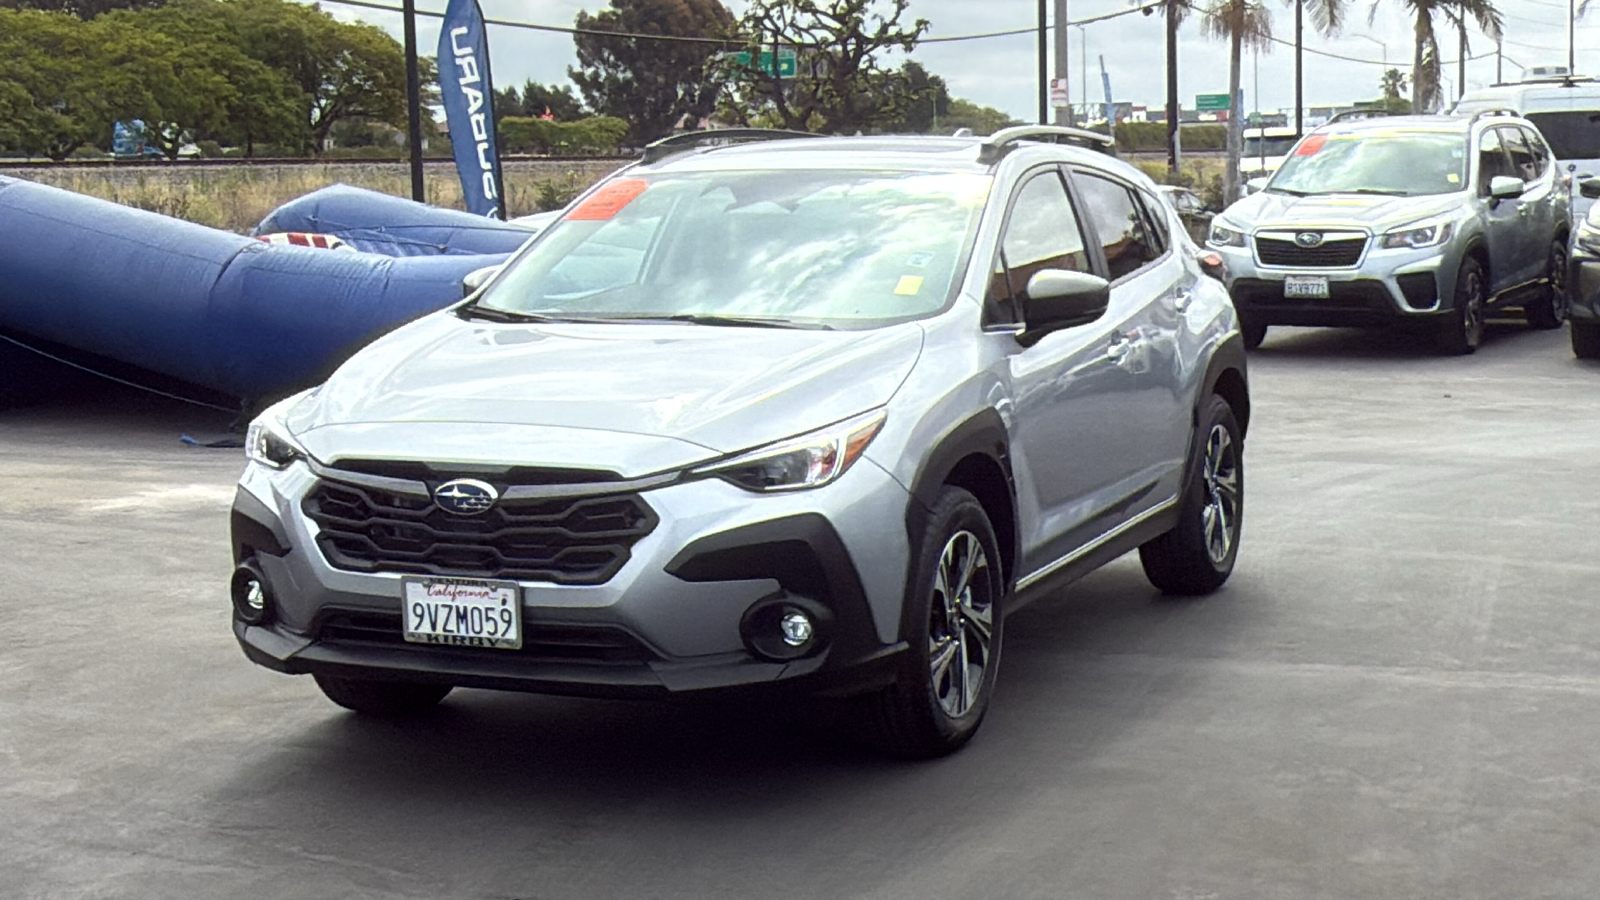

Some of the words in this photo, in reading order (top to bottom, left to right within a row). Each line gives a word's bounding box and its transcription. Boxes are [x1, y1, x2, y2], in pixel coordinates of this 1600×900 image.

[427, 583, 499, 602] California
[412, 602, 512, 637] 9VZM059
[426, 634, 500, 647] KIRBY
